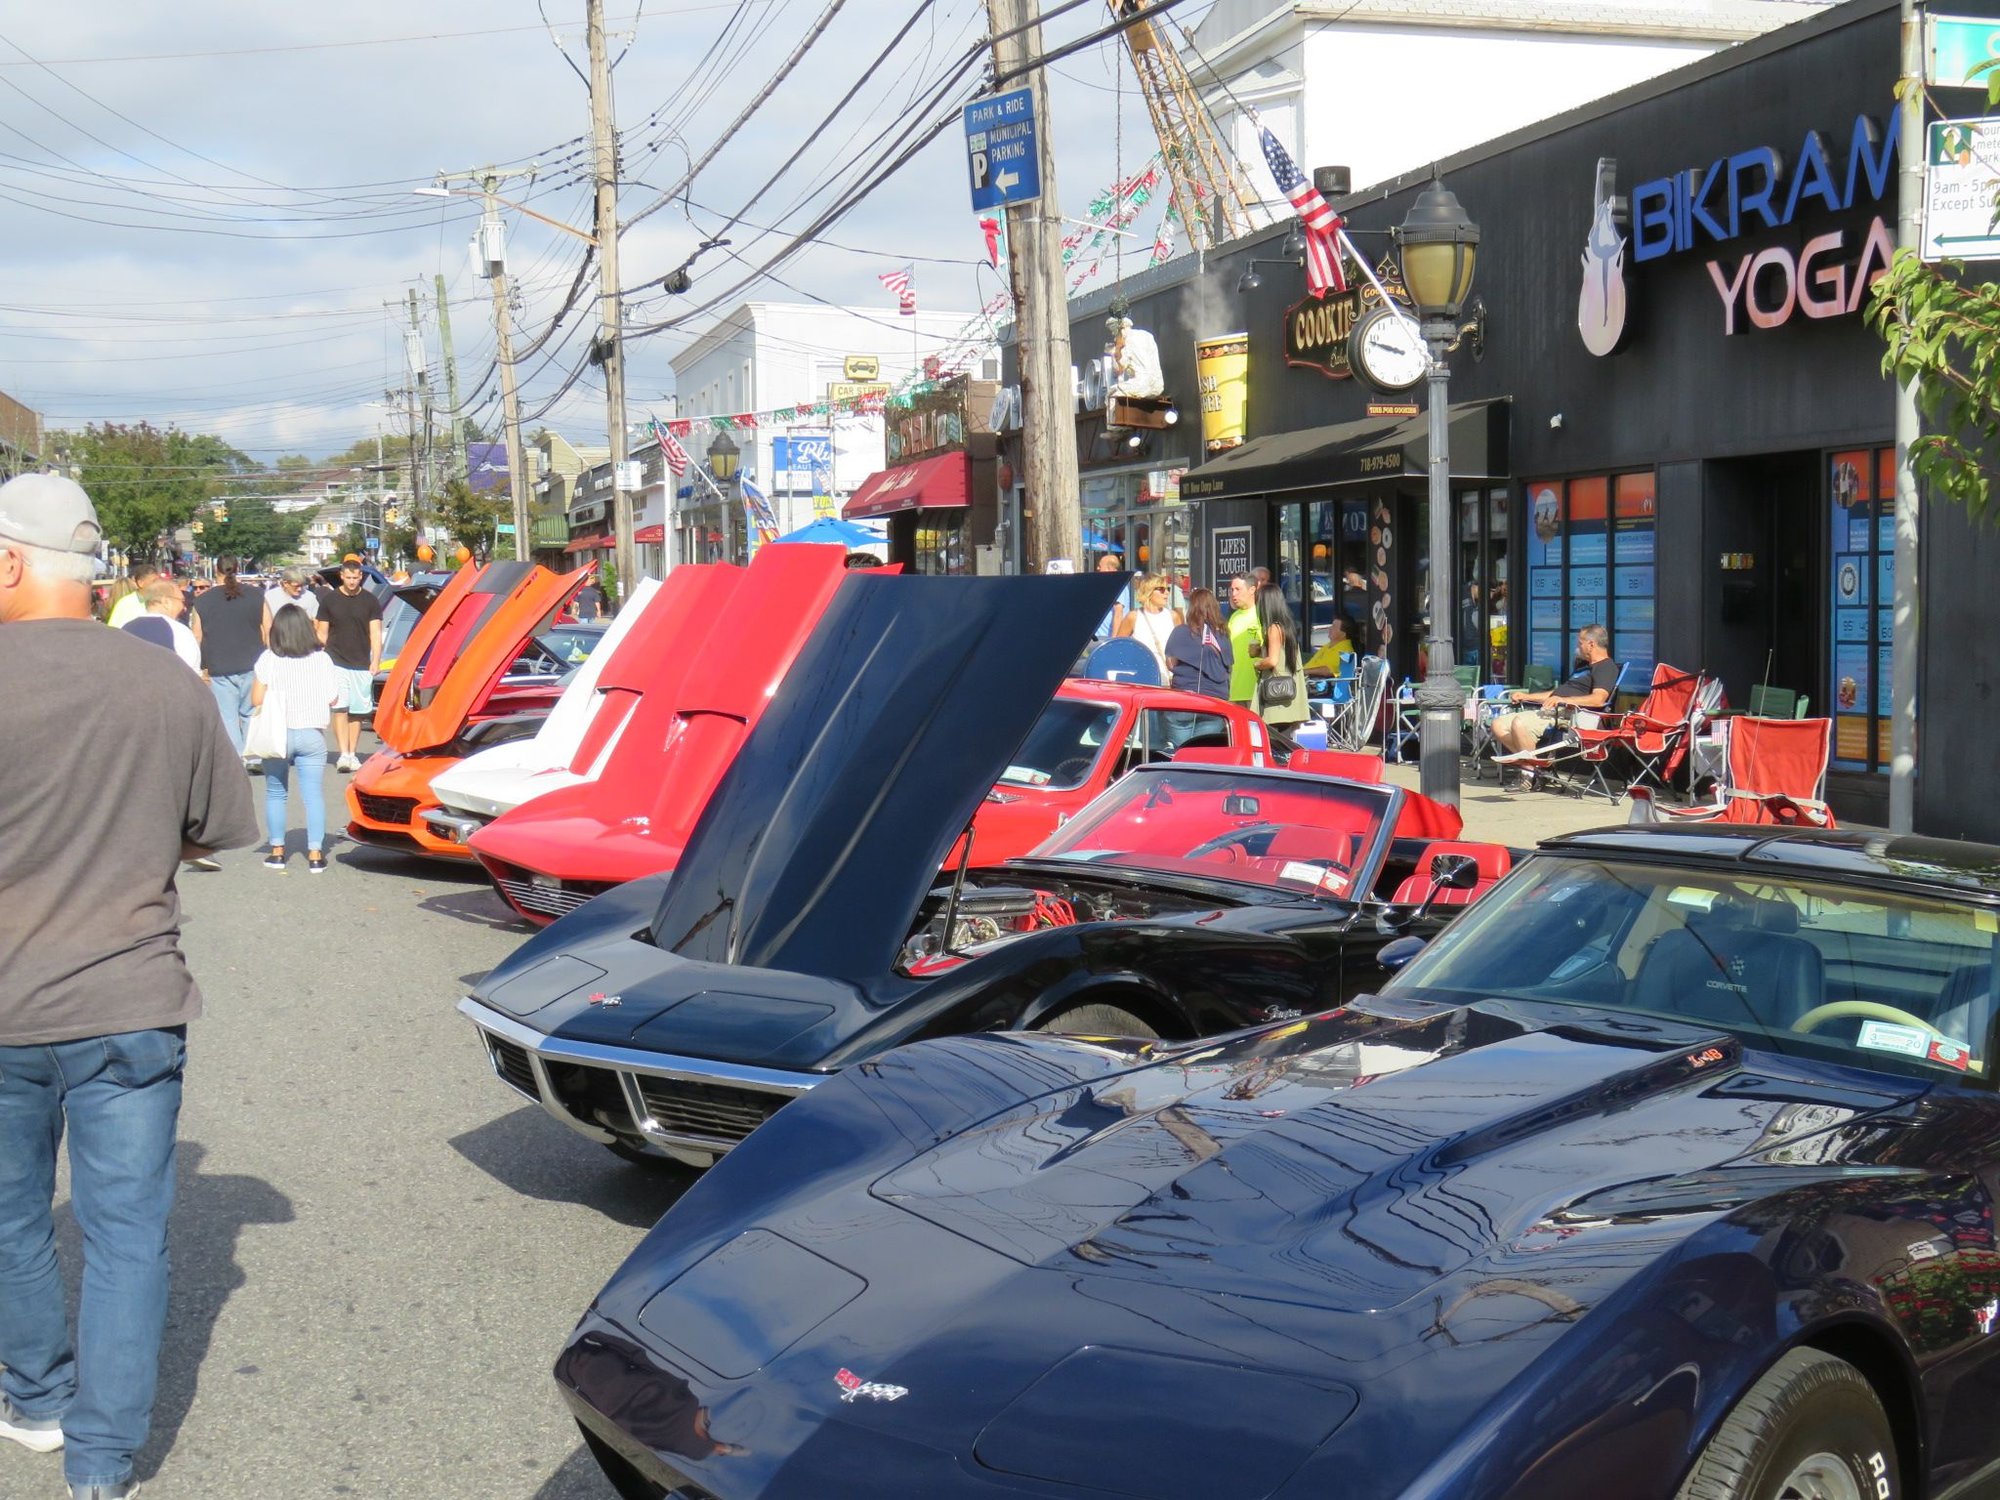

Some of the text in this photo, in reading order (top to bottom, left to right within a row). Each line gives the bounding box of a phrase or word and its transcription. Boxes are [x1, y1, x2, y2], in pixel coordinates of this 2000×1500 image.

[972, 97, 1024, 123] PARK & RIDE
[990, 120, 1032, 144] MUNICIPAL
[991, 141, 1025, 163] PARKING
[972, 153, 988, 190] P
[1632, 102, 1903, 263] BIKRAM
[1933, 182, 1960, 195] 9am
[1932, 198, 1974, 211] Except
[1706, 215, 1896, 336] YOGA
[1363, 285, 1395, 299] COOIE
[1295, 299, 1353, 350] COOKIE
[838, 386, 854, 396] CAR
[1213, 479, 1224, 491] Lane
[1220, 537, 1246, 555] LIFE'S
[1219, 557, 1247, 575] TOUGH
[1706, 980, 1748, 993] CORVETTE
